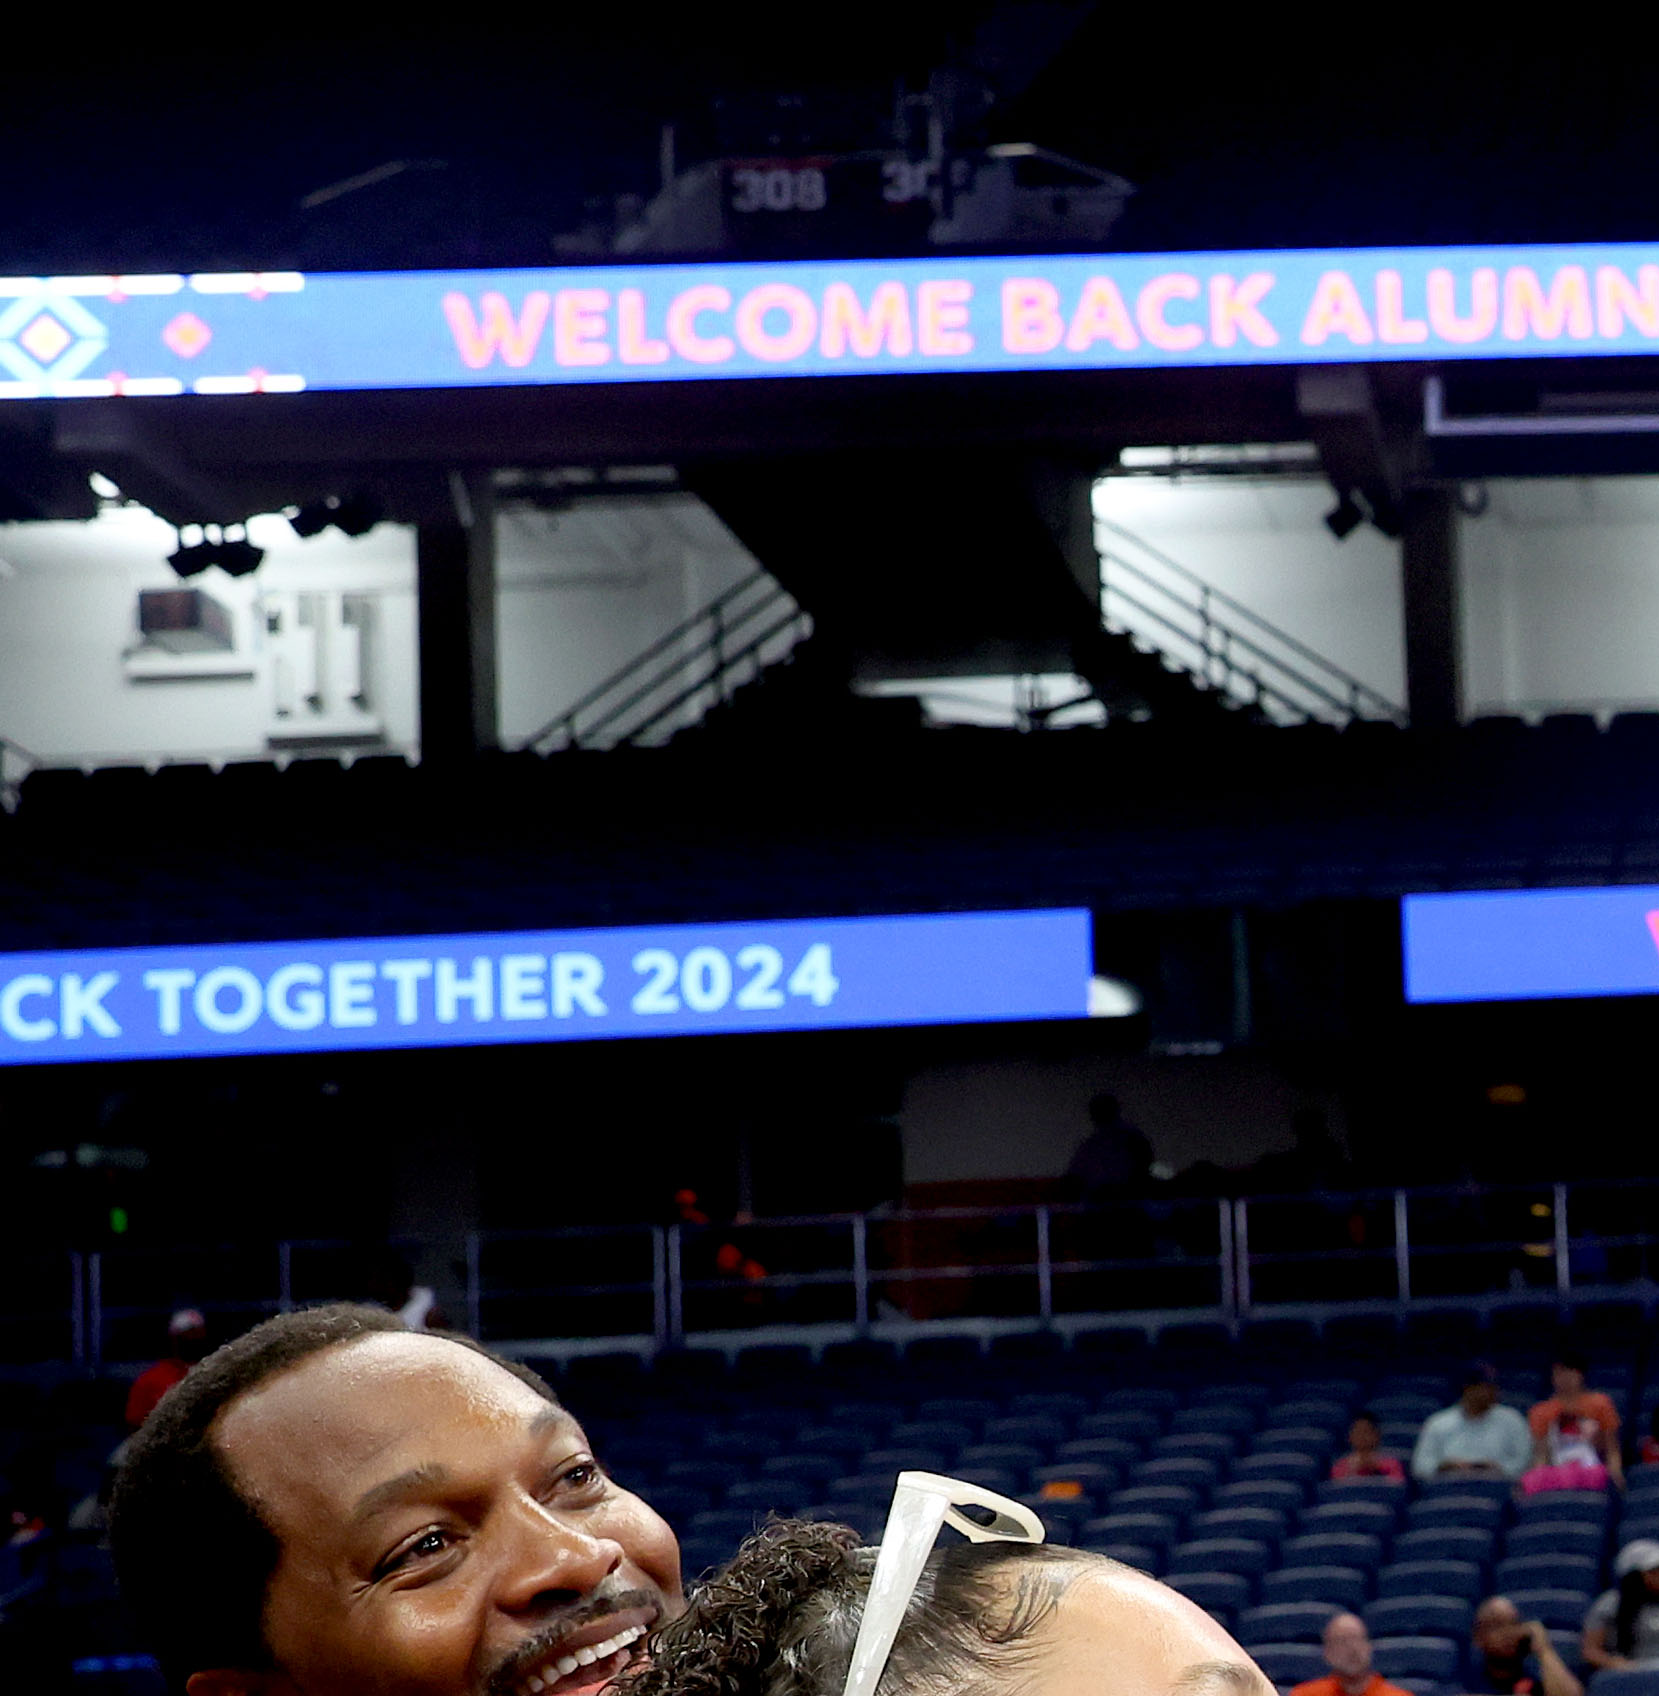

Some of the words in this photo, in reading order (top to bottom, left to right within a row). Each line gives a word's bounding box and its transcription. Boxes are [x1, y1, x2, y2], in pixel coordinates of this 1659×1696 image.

[442, 280, 974, 369] WELCOME
[1003, 271, 1280, 354] BACK
[0, 970, 123, 1042] CK
[143, 951, 608, 1036] TOGETHER
[630, 944, 840, 1015] 2024
